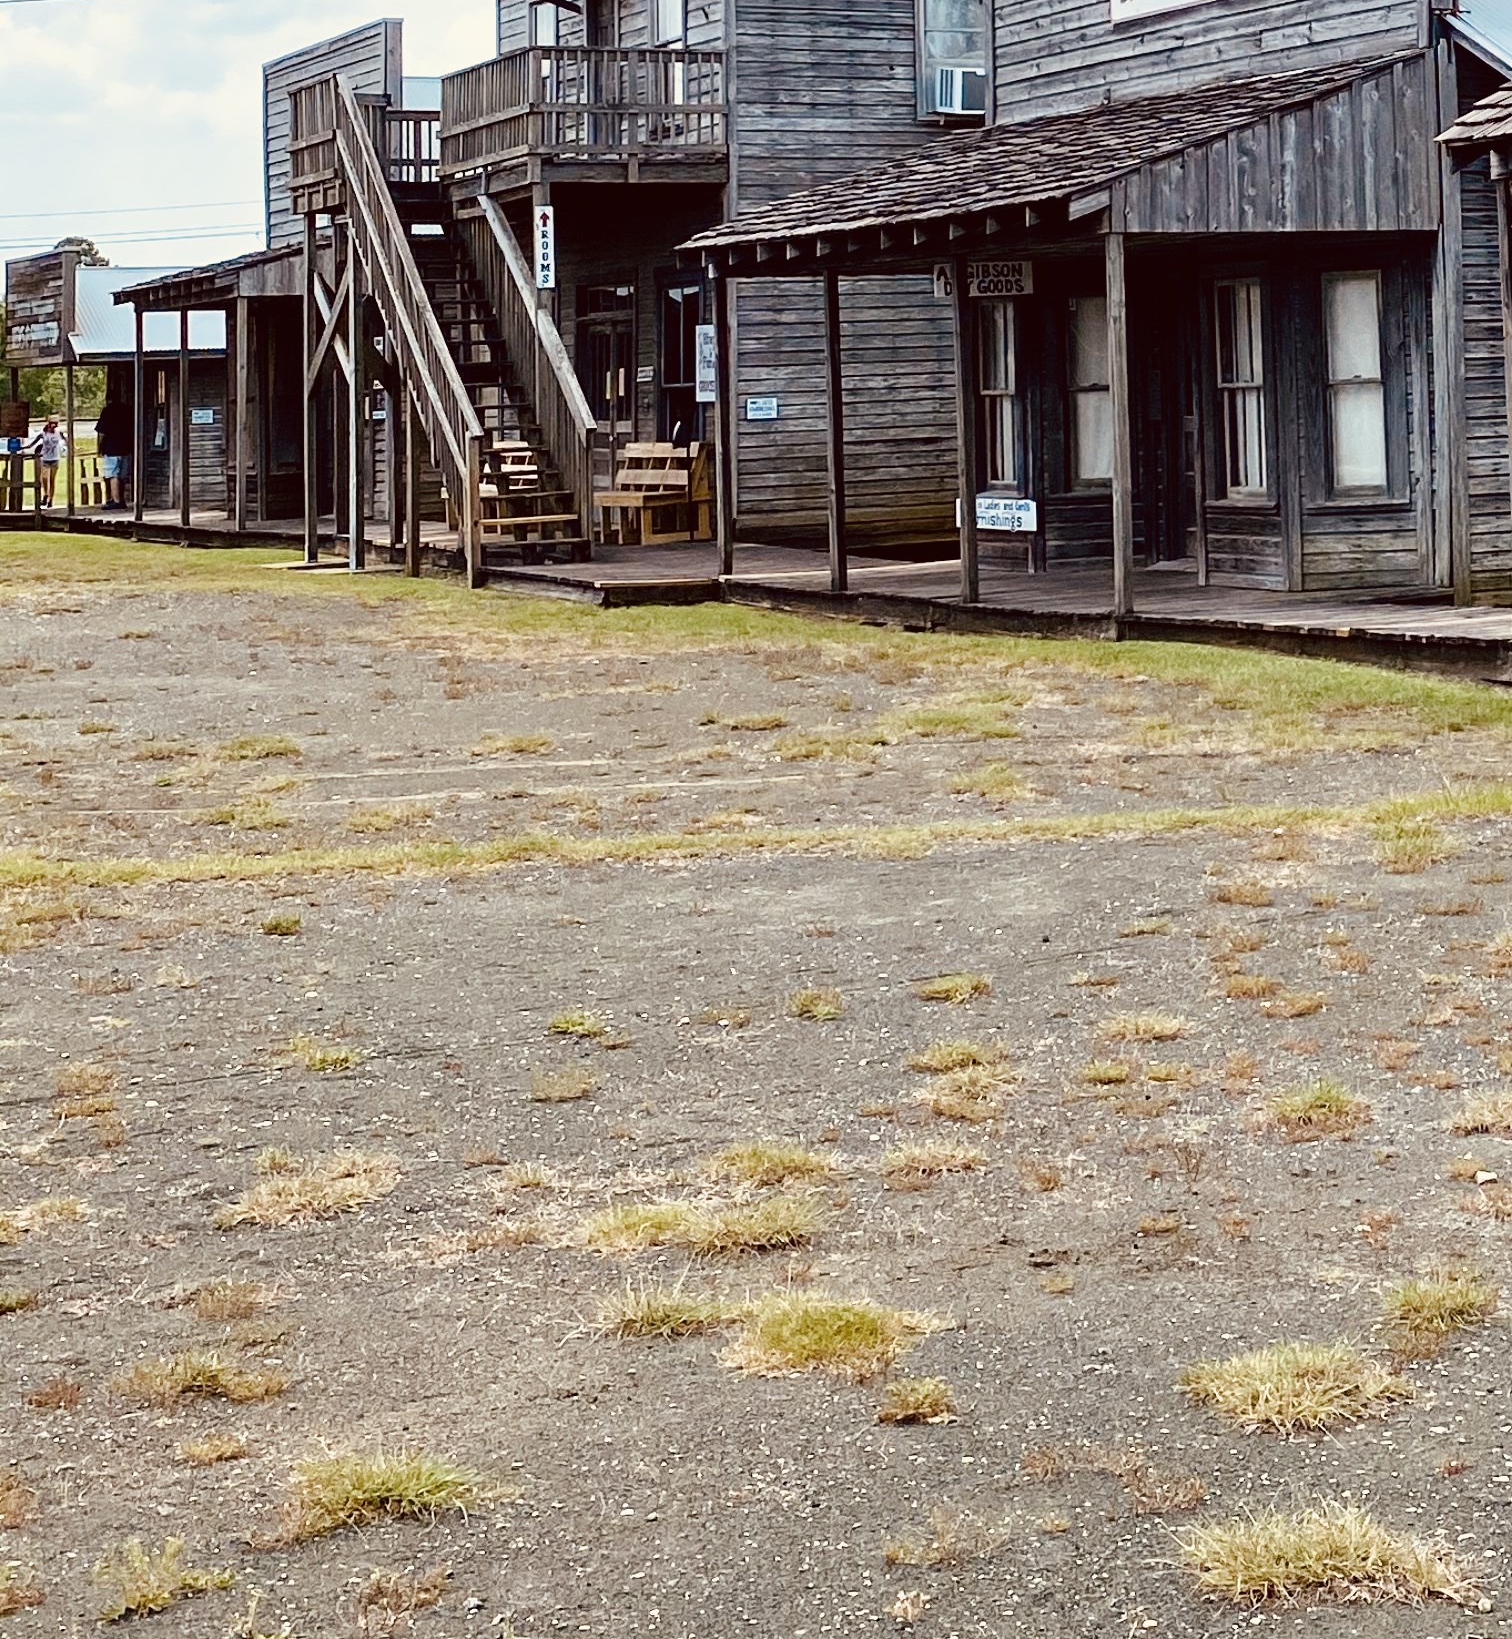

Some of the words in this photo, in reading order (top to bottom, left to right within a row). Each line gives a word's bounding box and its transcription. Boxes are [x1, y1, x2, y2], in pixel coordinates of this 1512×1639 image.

[540, 230, 551, 284] ROOMS
[967, 263, 1023, 279] GIBSON
[977, 278, 1025, 294] GOODS
